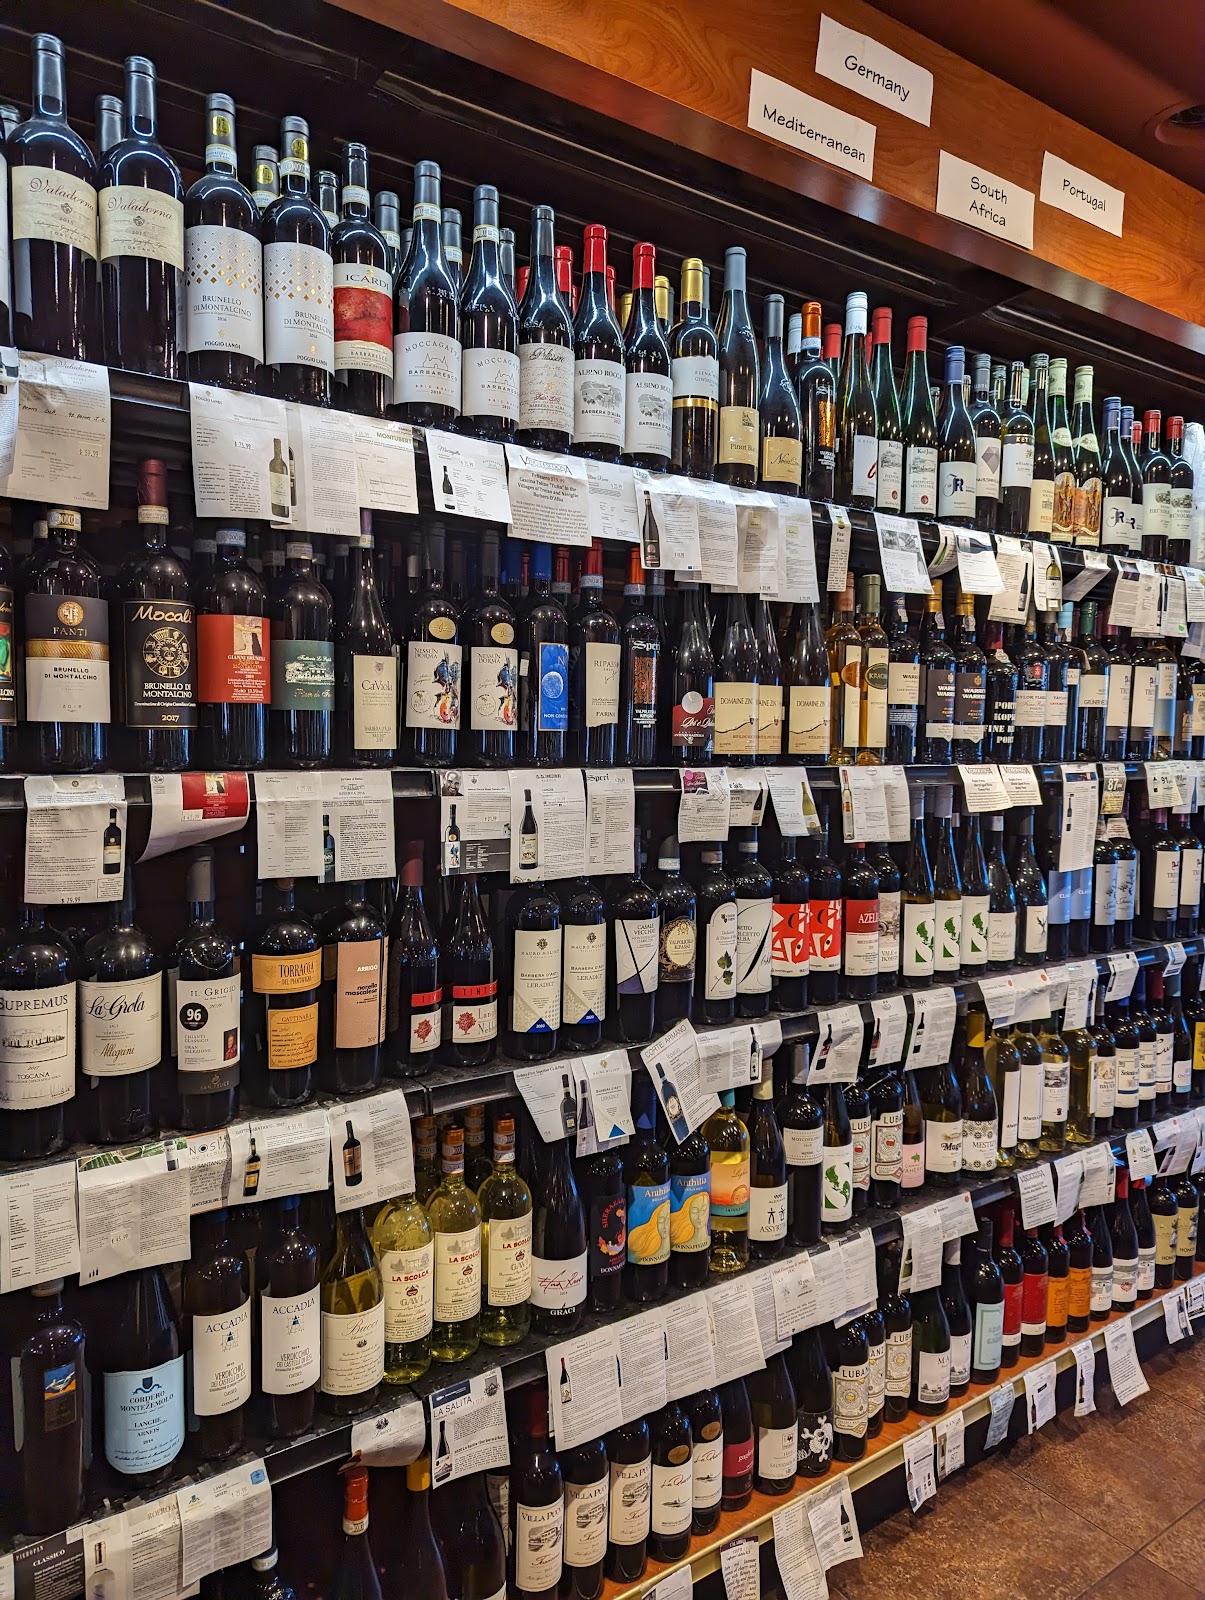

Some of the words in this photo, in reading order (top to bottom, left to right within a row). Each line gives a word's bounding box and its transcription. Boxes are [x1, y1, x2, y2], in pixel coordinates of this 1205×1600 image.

[843, 54, 910, 102] Germany
[763, 104, 866, 163] Mediterranean
[30, 178, 95, 211] Valadorna
[970, 176, 1008, 205] South
[1062, 178, 1107, 212] Portugal
[108, 197, 173, 220] Valadorna
[969, 200, 1007, 228] Africa
[345, 274, 390, 290] ICARDI
[202, 295, 242, 306] BRUNELLO
[200, 304, 252, 318] MONTALCINO
[294, 310, 328, 325] BRUNELLO
[296, 354, 315, 364] POGGIO
[476, 358, 520, 372] MOCCAGAT
[408, 370, 458, 382] BARBARESCO
[481, 384, 520, 396] BARBARES
[132, 606, 192, 624] Mocali
[53, 626, 88, 637] FANTI
[144, 682, 183, 690] BRUNELLO
[184, 683, 192, 691] DI
[143, 690, 192, 698] MONTALCINO
[161, 714, 180, 722] 2017
[587, 774, 610, 782] Speri
[1108, 778, 1118, 790] 87
[356, 964, 378, 972] ARRIGO
[204, 985, 236, 997] GRIGIO
[85, 995, 106, 1019] La
[104, 992, 145, 1021] Grola
[186, 1008, 202, 1021] 96
[645, 1041, 664, 1058] CORTE
[664, 1024, 687, 1044] ARMANO
[93, 1043, 136, 1063] Allegrini
[676, 1176, 707, 1187] Anthilia
[460, 1249, 481, 1263] SCOLCA
[404, 1269, 429, 1282] SCOLCA
[457, 1274, 478, 1286] GAVI
[272, 1298, 315, 1314] ACCADIA
[400, 1295, 424, 1307] GAVI
[550, 1306, 576, 1316] GRACI
[205, 1312, 248, 1333] ACCADIA
[342, 1316, 379, 1337] Bucci
[280, 1348, 310, 1362] VERDICCHIO
[215, 1362, 244, 1381] VERDICCHIO
[120, 1394, 174, 1412] MONTEZEMOLO
[129, 1390, 165, 1404] CORDERO
[433, 1408, 444, 1418] LA
[134, 1417, 162, 1428] LANGHE
[136, 1427, 160, 1438] ARNEIS
[147, 1506, 171, 1520] ROERO
[33, 1549, 65, 1567] CLASSICO
